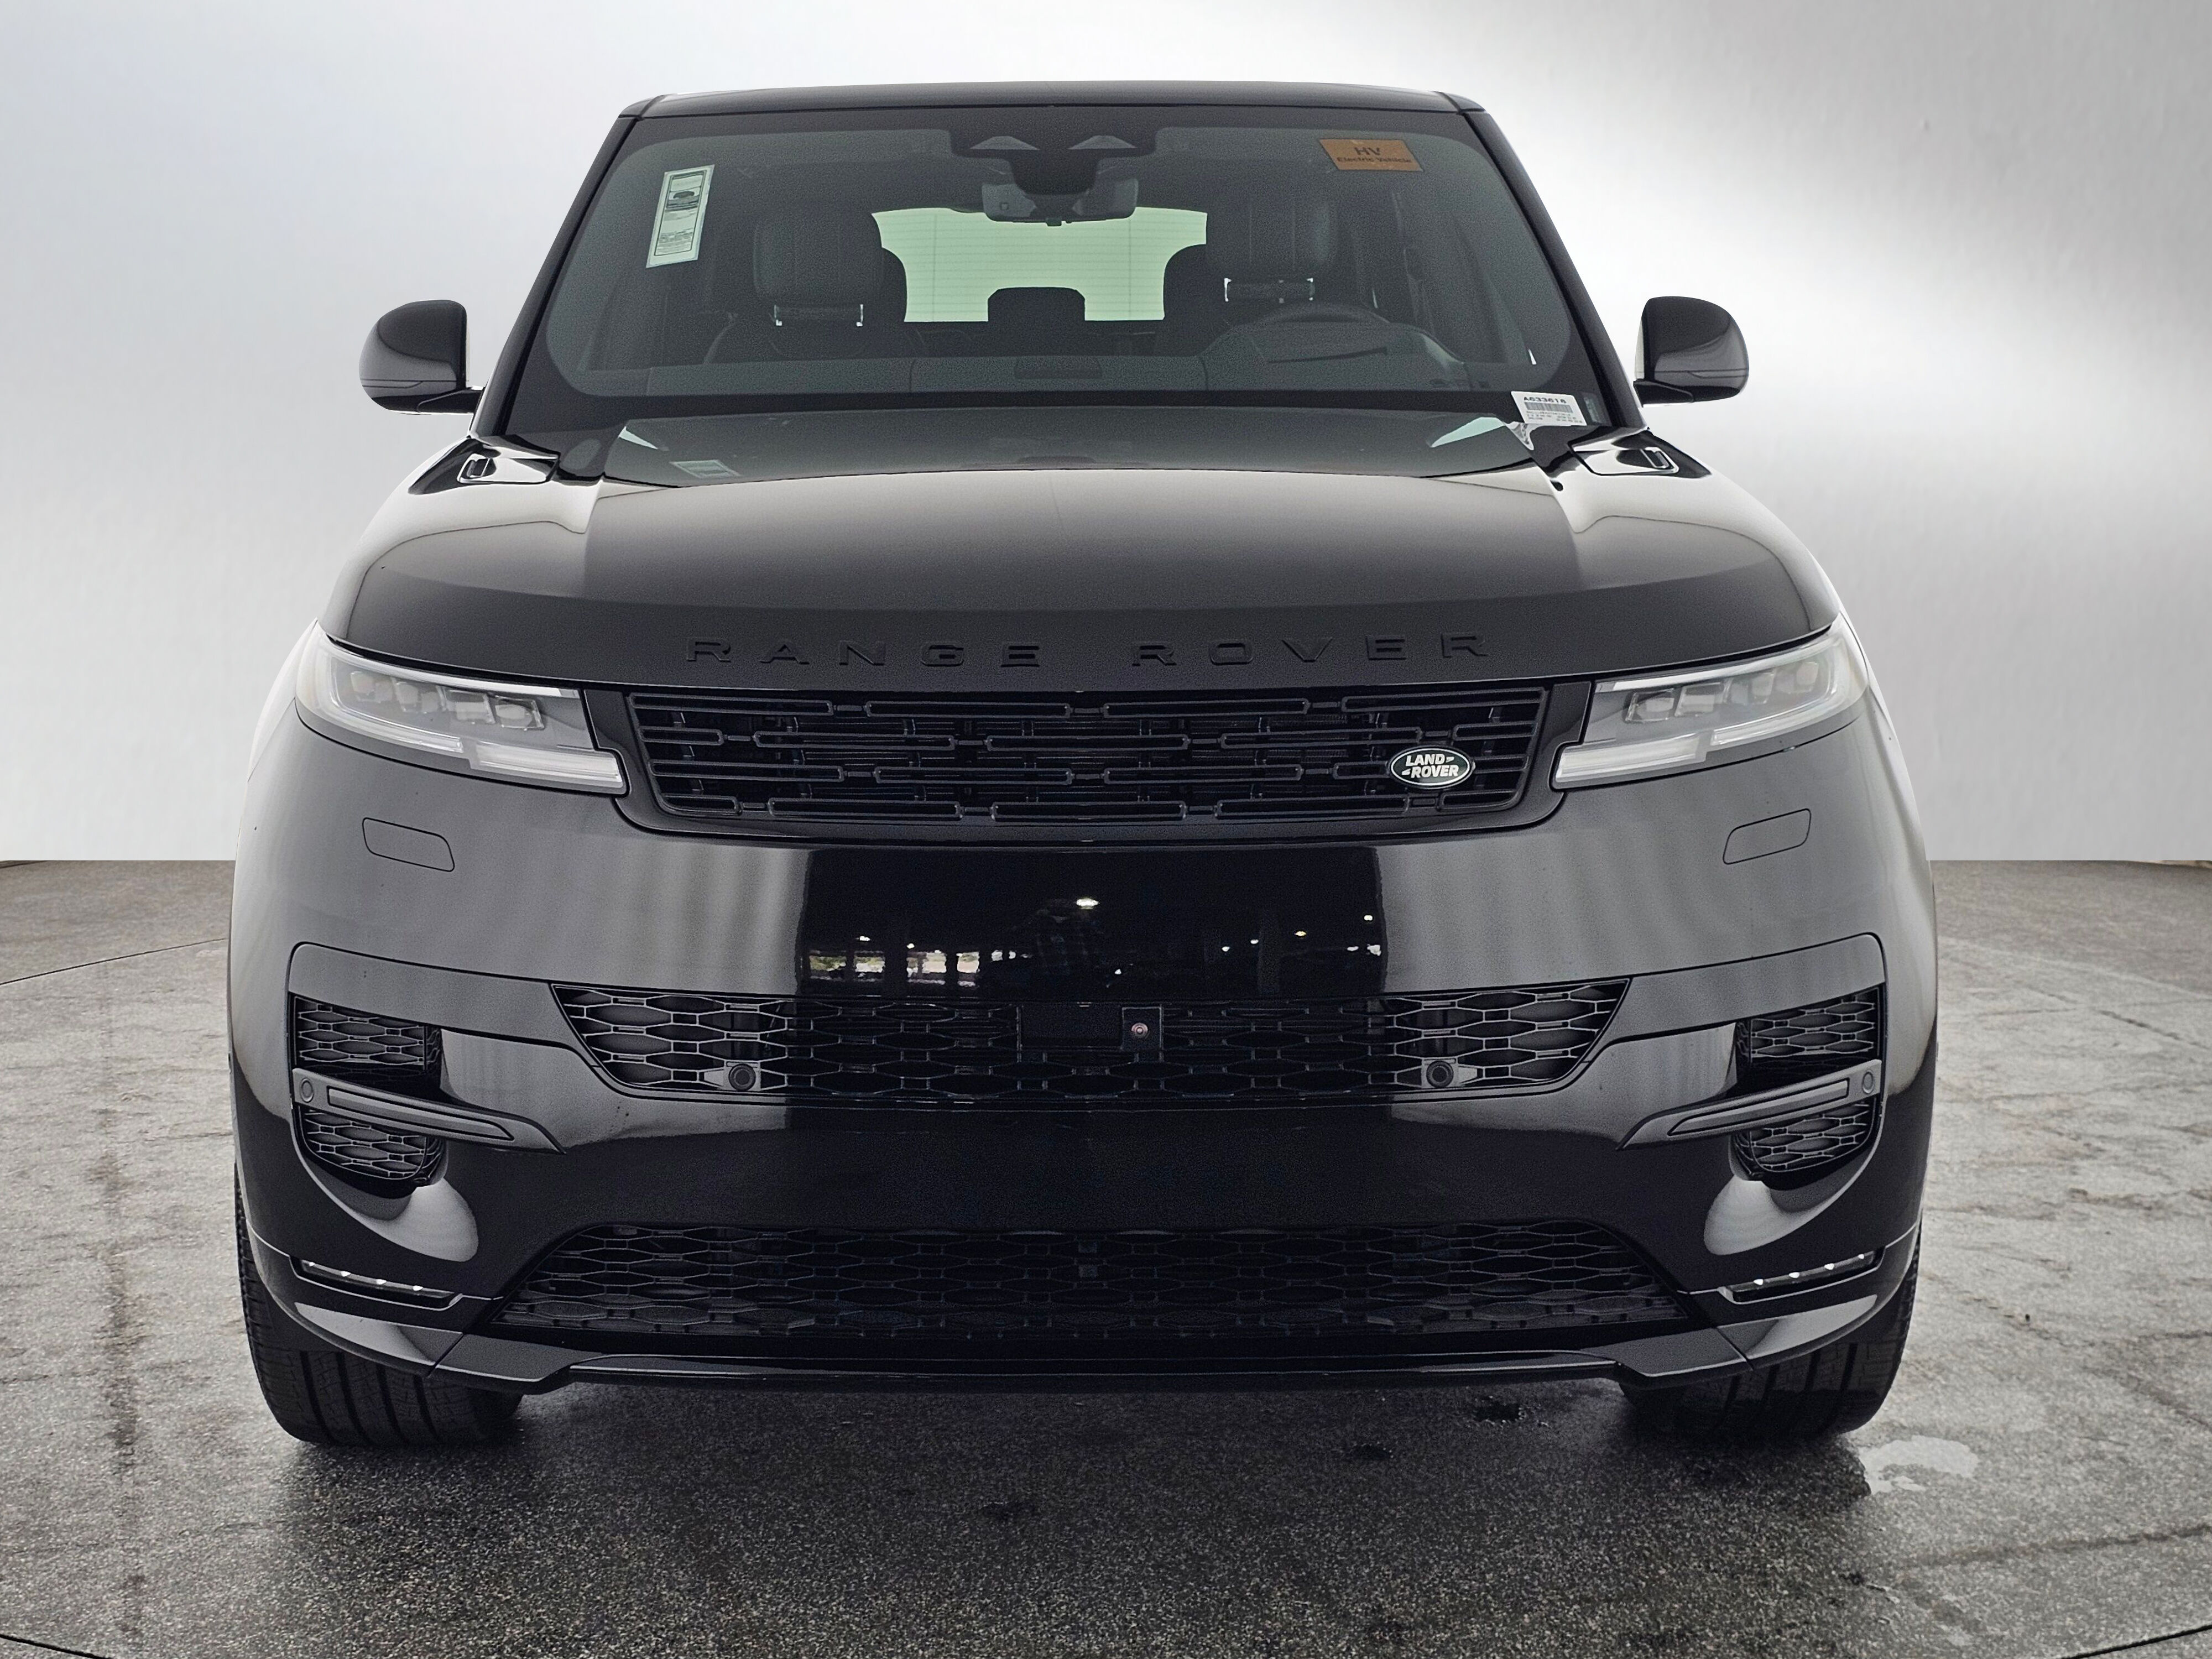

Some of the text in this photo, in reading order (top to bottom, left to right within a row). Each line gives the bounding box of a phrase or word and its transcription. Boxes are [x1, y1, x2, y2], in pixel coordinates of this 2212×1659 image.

[1354, 147, 1381, 155] HV
[686, 632, 1489, 667] RANGE ROVER
[1405, 754, 1446, 766] LAND
[1410, 764, 1460, 779] ROVER
